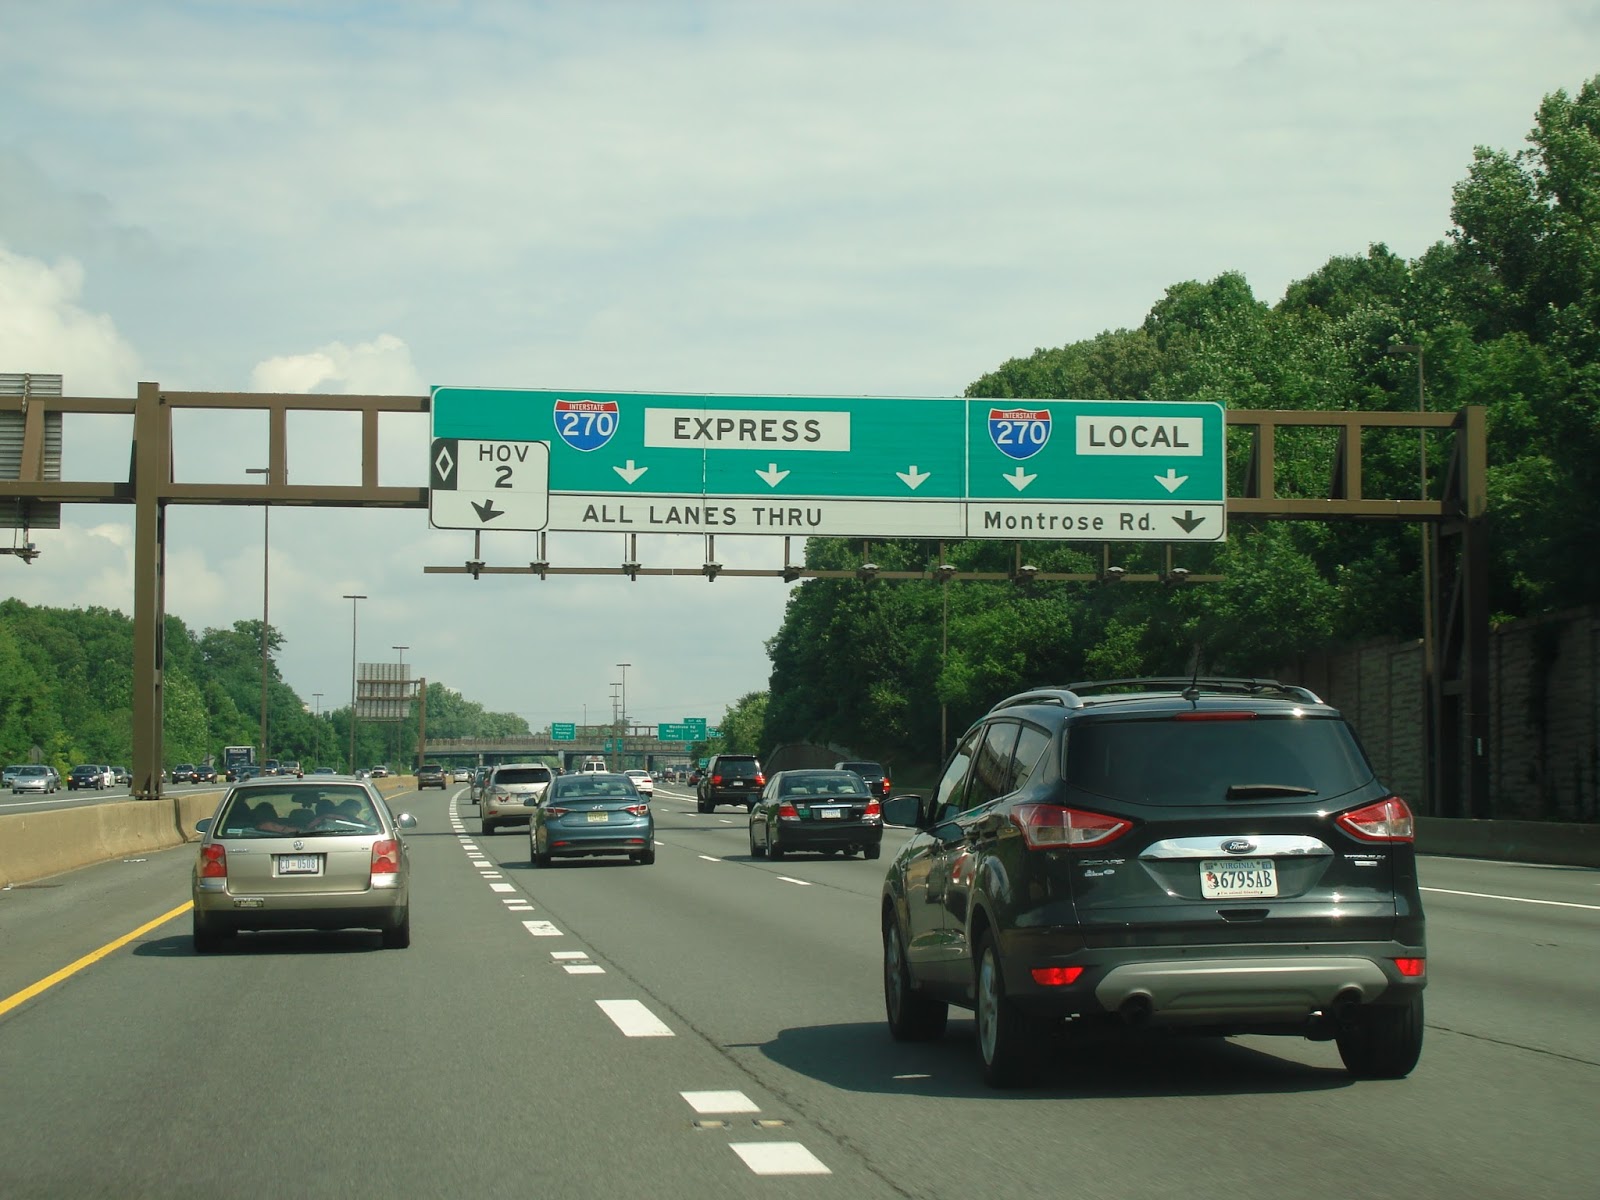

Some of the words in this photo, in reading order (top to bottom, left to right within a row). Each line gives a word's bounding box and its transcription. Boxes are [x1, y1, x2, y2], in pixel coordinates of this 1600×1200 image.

[568, 403, 605, 412] INTERSTATE
[1002, 411, 1037, 420] INTERSTATE
[562, 412, 614, 436] 270
[673, 416, 822, 443] EXPRESS
[996, 421, 1047, 445] 270
[1089, 424, 1189, 448] LOCAL
[478, 443, 529, 463] HOV
[494, 465, 513, 489] 2
[582, 504, 633, 524] ALL
[649, 505, 737, 525] LANES
[752, 507, 822, 527] THRU
[984, 510, 1104, 531] Montrose
[1119, 512, 1156, 531] Rd.
[1229, 841, 1250, 850] Ford
[1220, 862, 1256, 870] VIRGINIA
[1220, 870, 1272, 889] 6795AB
